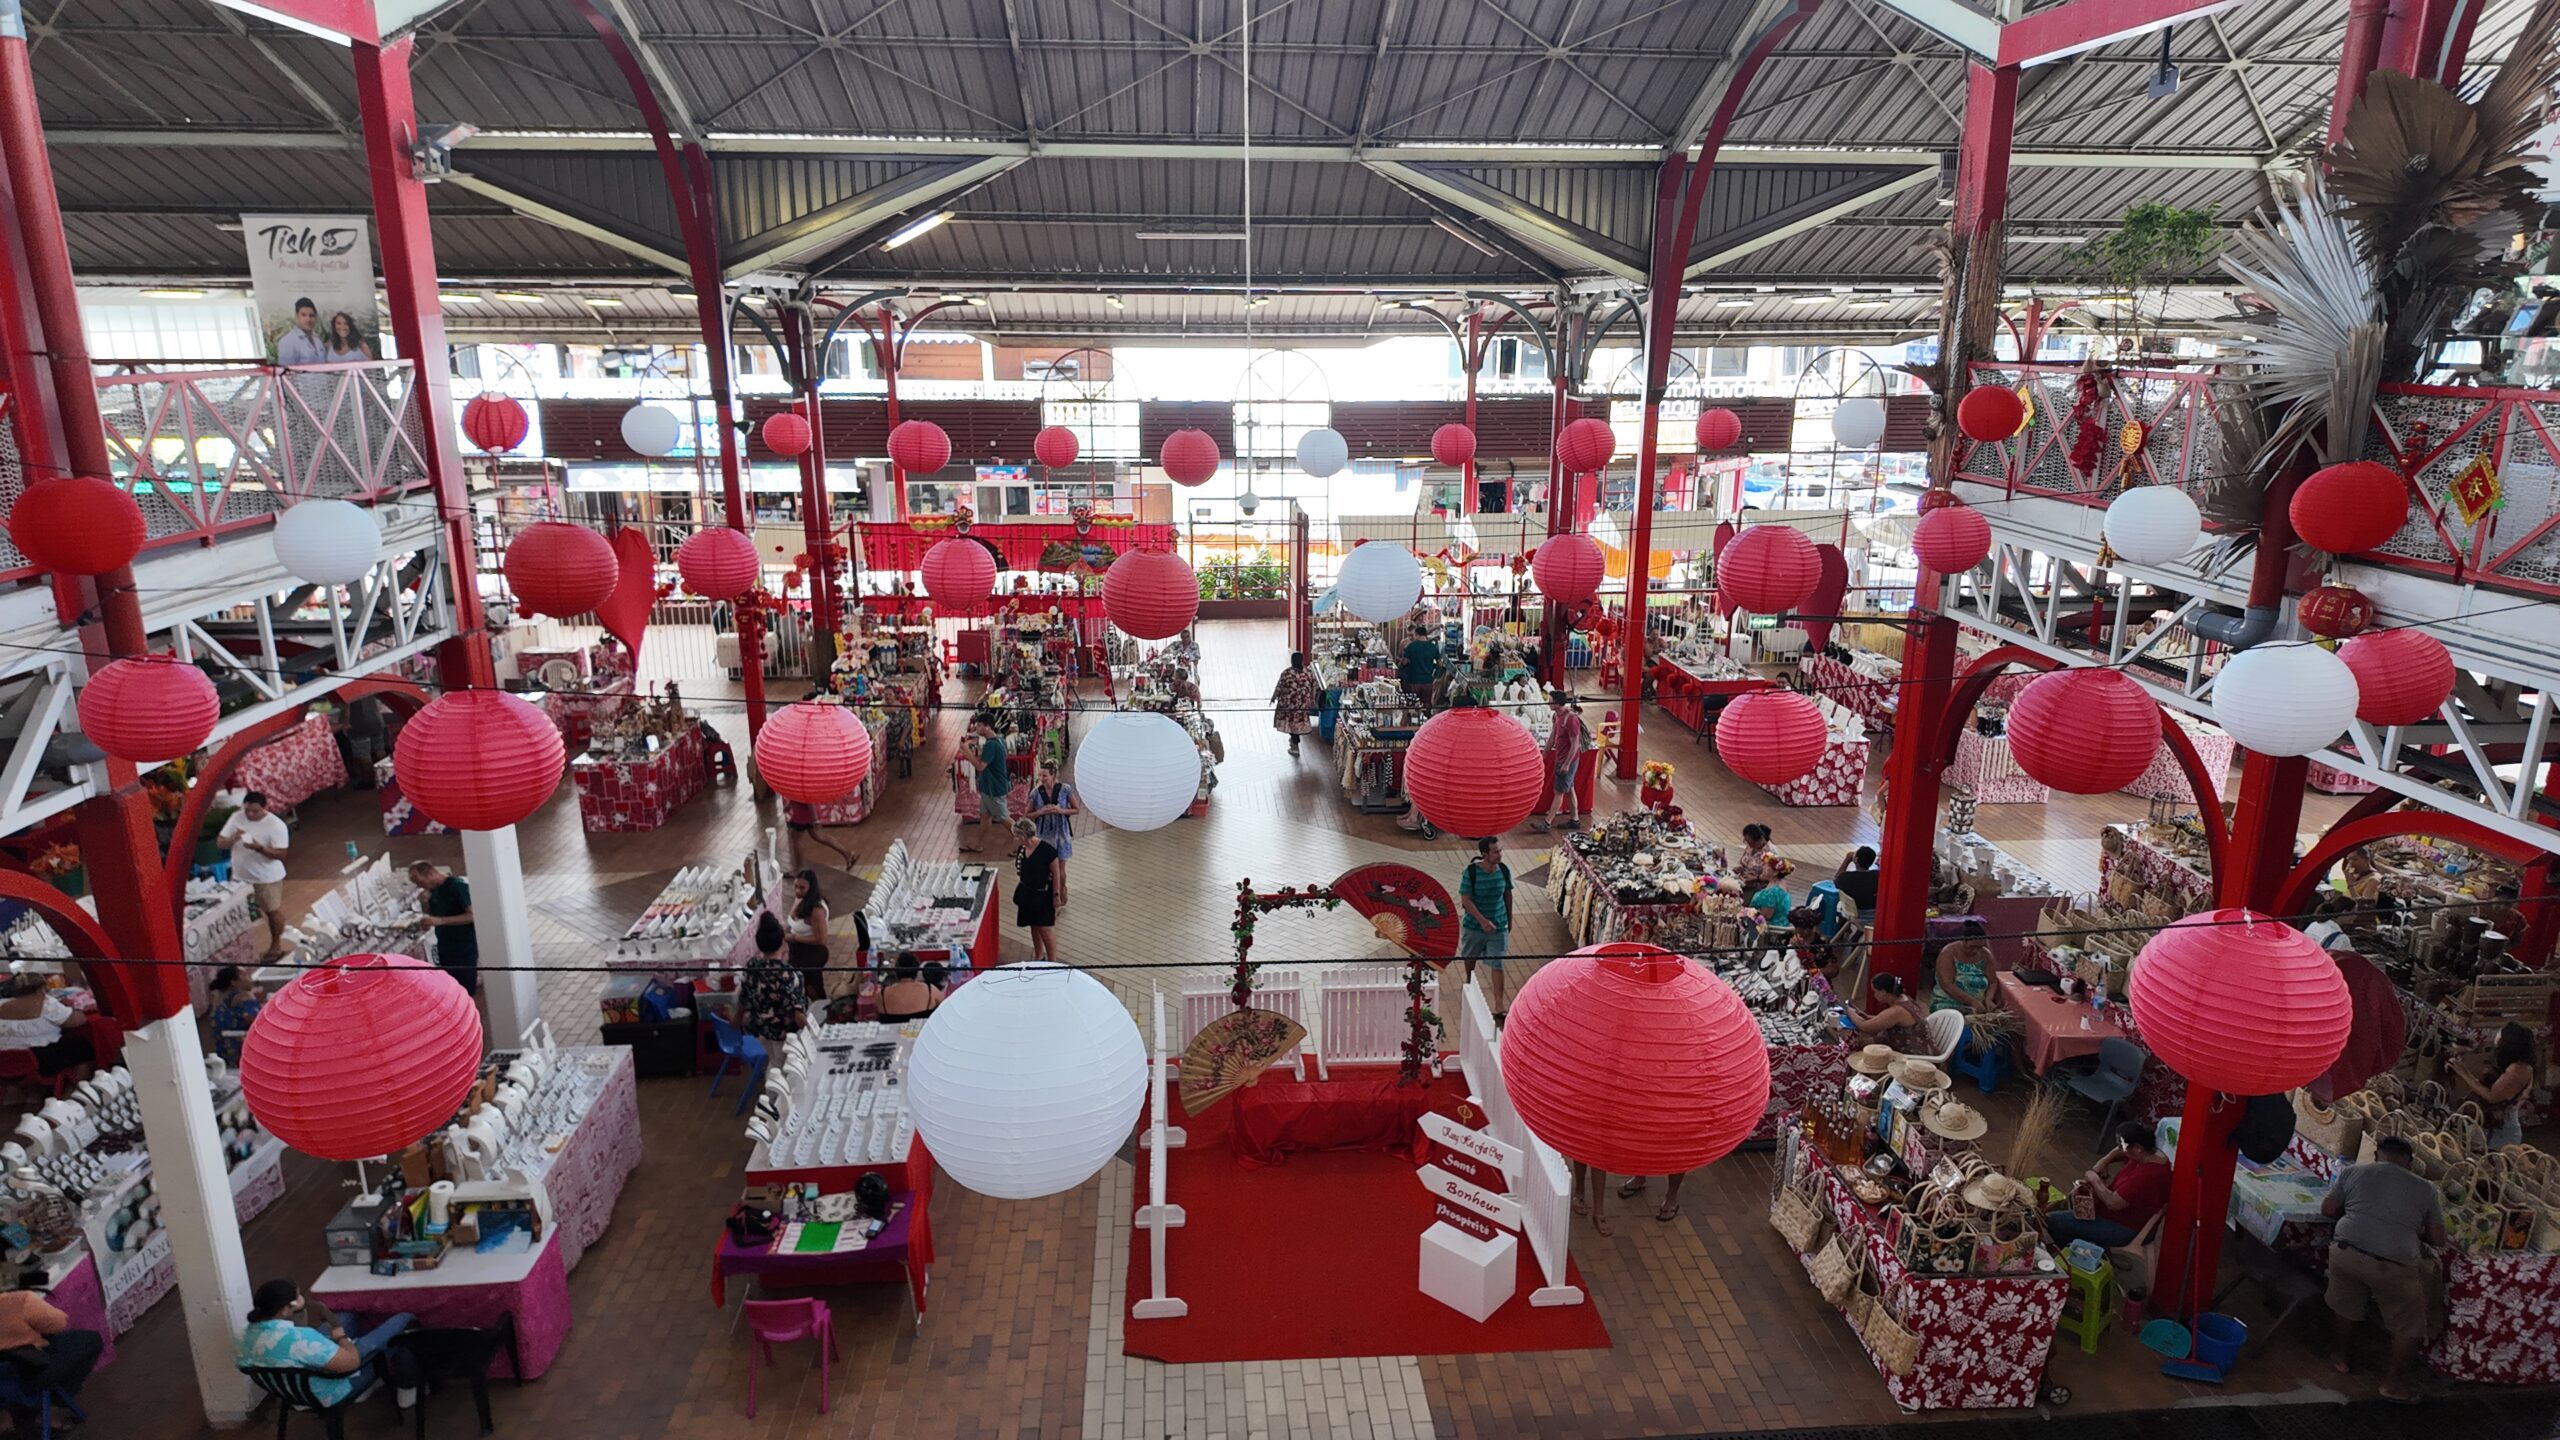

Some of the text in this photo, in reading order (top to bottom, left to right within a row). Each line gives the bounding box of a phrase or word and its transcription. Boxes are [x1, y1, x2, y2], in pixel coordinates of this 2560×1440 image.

[258, 225, 316, 260] Tish
[1442, 1154, 1477, 1175] Santé
[1446, 1181, 1501, 1213] Bonheur
